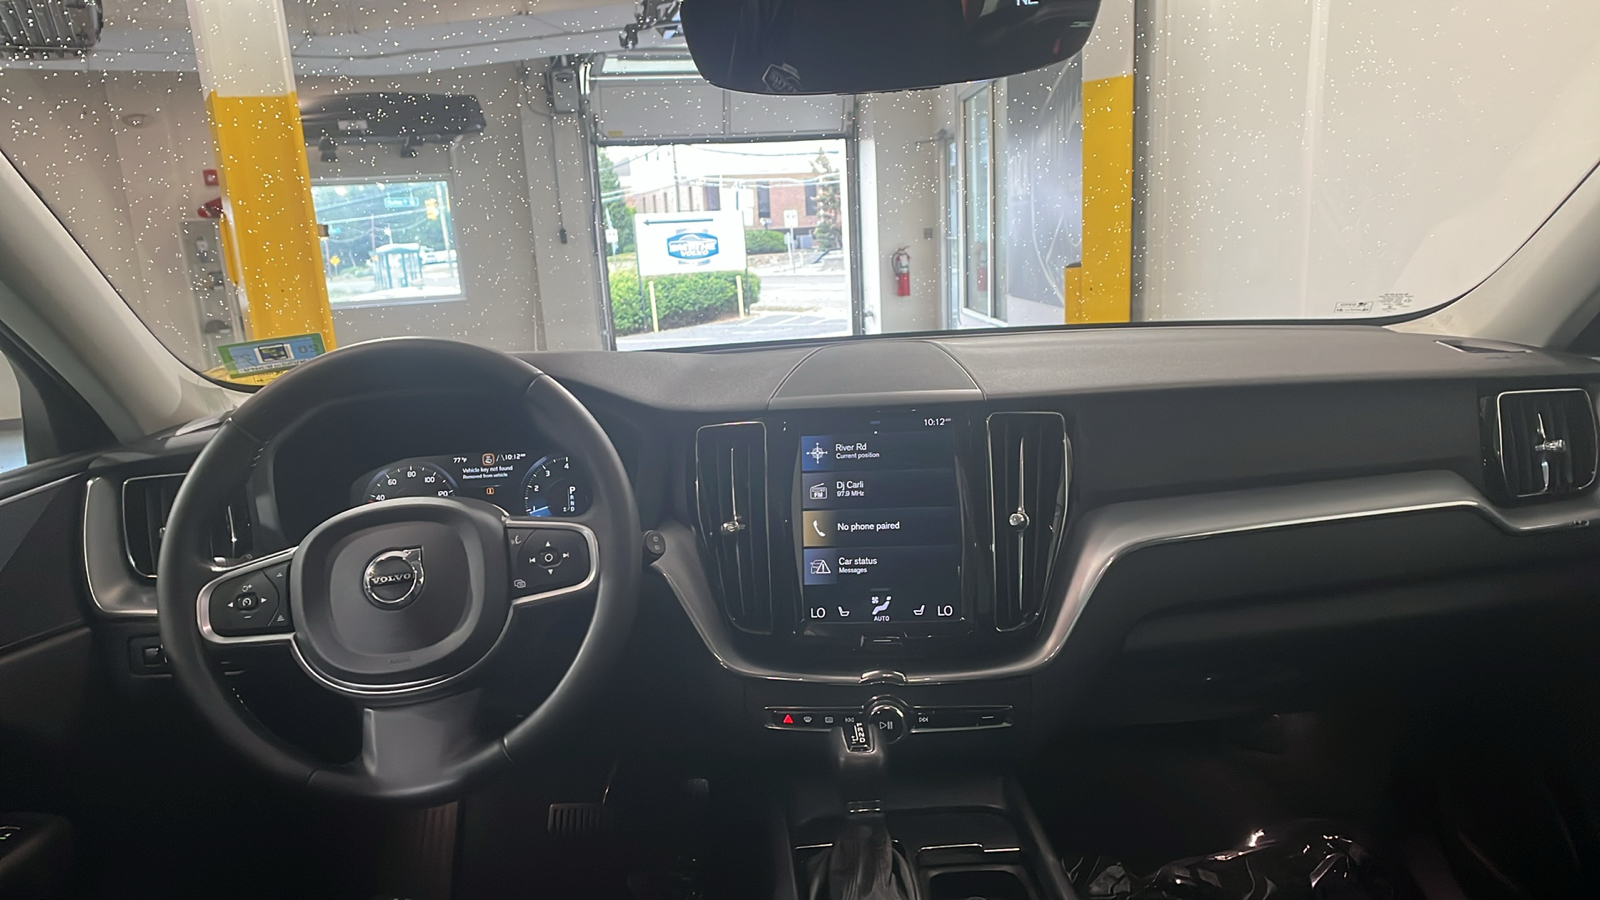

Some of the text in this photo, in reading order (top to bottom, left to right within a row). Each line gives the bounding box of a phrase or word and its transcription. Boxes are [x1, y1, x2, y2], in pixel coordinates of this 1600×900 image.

[835, 443, 867, 452] River Rd
[387, 478, 397, 486] 60
[836, 480, 864, 491] Dj Carli
[569, 486, 576, 495] P
[837, 521, 900, 532] No phone paired
[838, 557, 877, 566] Car status
[371, 573, 411, 584] VOLVO
[810, 607, 826, 618] LO
[937, 605, 953, 616] LO
